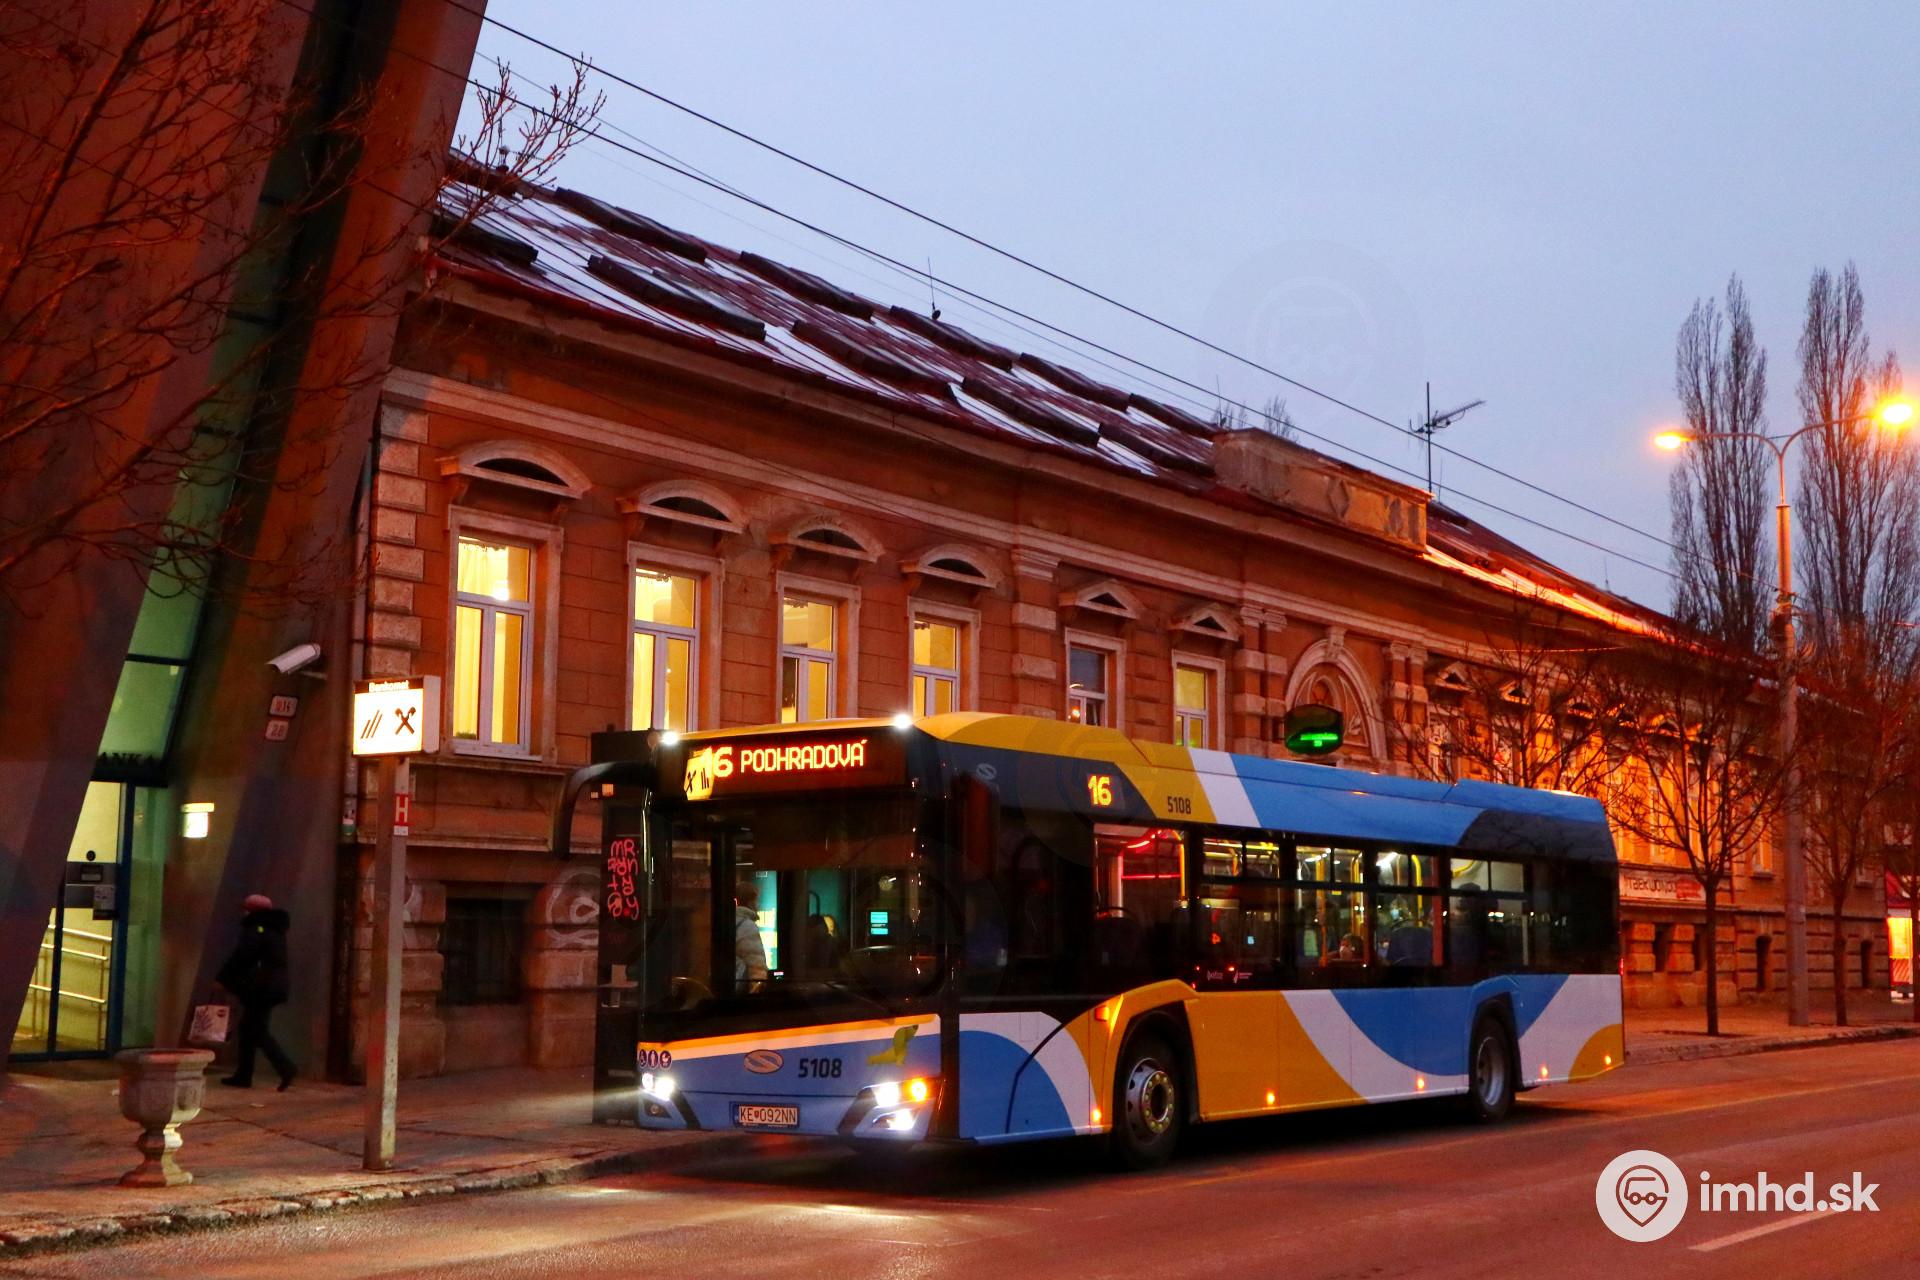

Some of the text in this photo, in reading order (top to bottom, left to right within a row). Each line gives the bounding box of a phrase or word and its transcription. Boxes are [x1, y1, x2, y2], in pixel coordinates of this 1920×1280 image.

[741, 740, 867, 773] PODHRADOVÁ
[1088, 775, 1112, 806] 16
[396, 796, 408, 822] H
[1167, 796, 1192, 815] 5108
[798, 1058, 842, 1078] 5108
